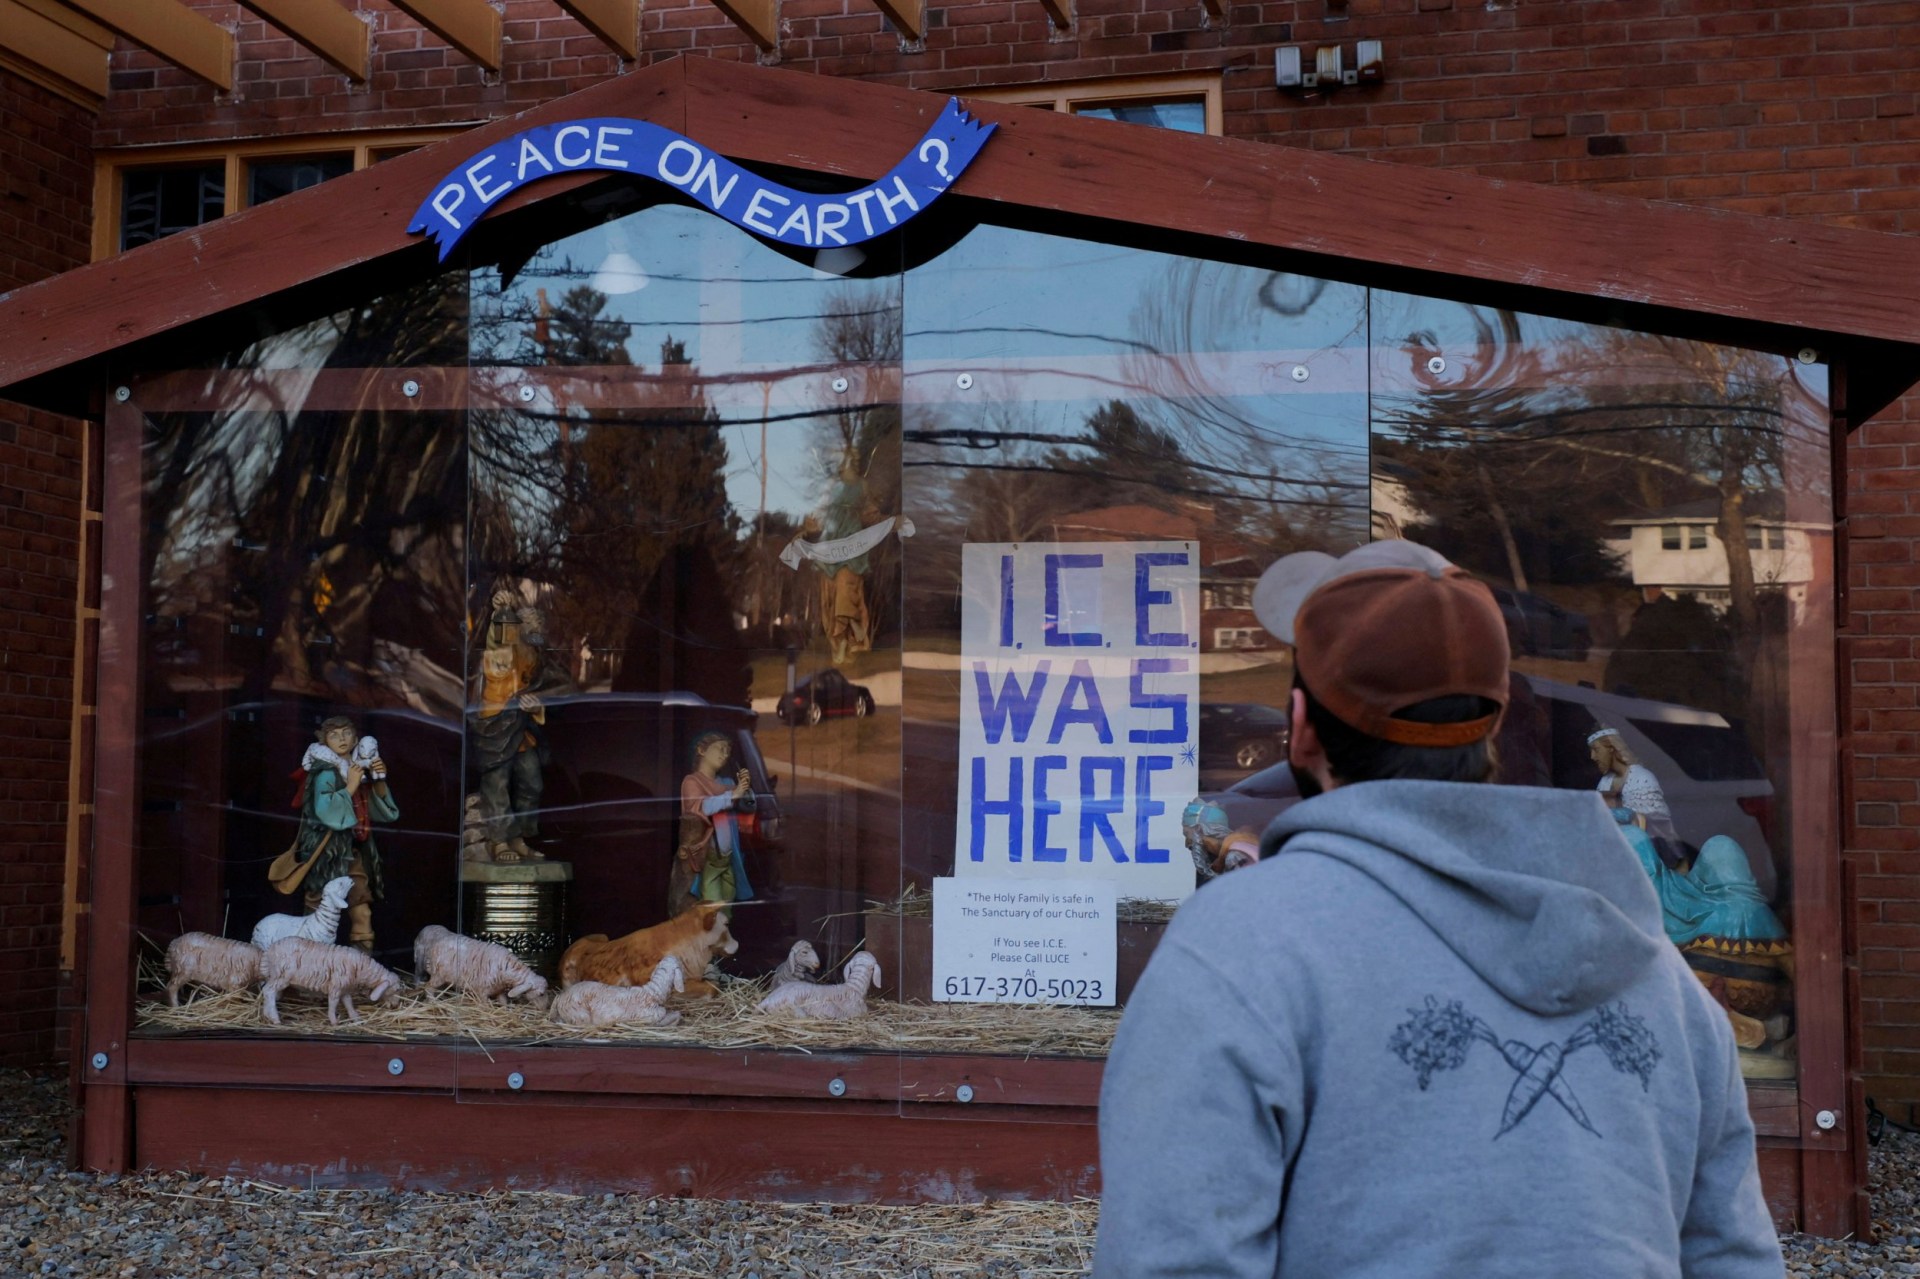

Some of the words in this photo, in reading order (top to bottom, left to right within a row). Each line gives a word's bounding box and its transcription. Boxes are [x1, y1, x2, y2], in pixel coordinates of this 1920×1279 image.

[431, 125, 633, 229] PEACE
[658, 140, 739, 209] ON
[742, 175, 919, 245] EARTH
[919, 138, 954, 182] ?
[1000, 553, 1197, 649] I.C.E.
[972, 659, 1189, 744] WAS
[994, 893, 1015, 903] Holy
[1019, 893, 1049, 904] Family
[1053, 894, 1059, 903] is
[1062, 894, 1082, 903] safe
[1085, 895, 1094, 903] in
[962, 908, 979, 916] The
[983, 908, 1030, 919] Sanctuary
[1033, 909, 1043, 917] of
[1046, 910, 1062, 918] our
[1065, 909, 1099, 919] Church
[994, 938, 1001, 947] If
[1003, 938, 1020, 947] You
[1043, 939, 1066, 948] I.C.E.
[991, 953, 1022, 962] Please
[1025, 953, 1042, 962] Call
[1046, 954, 1069, 963] LUCE
[1025, 969, 1035, 977] At
[946, 976, 1102, 999] 617-370-5023
